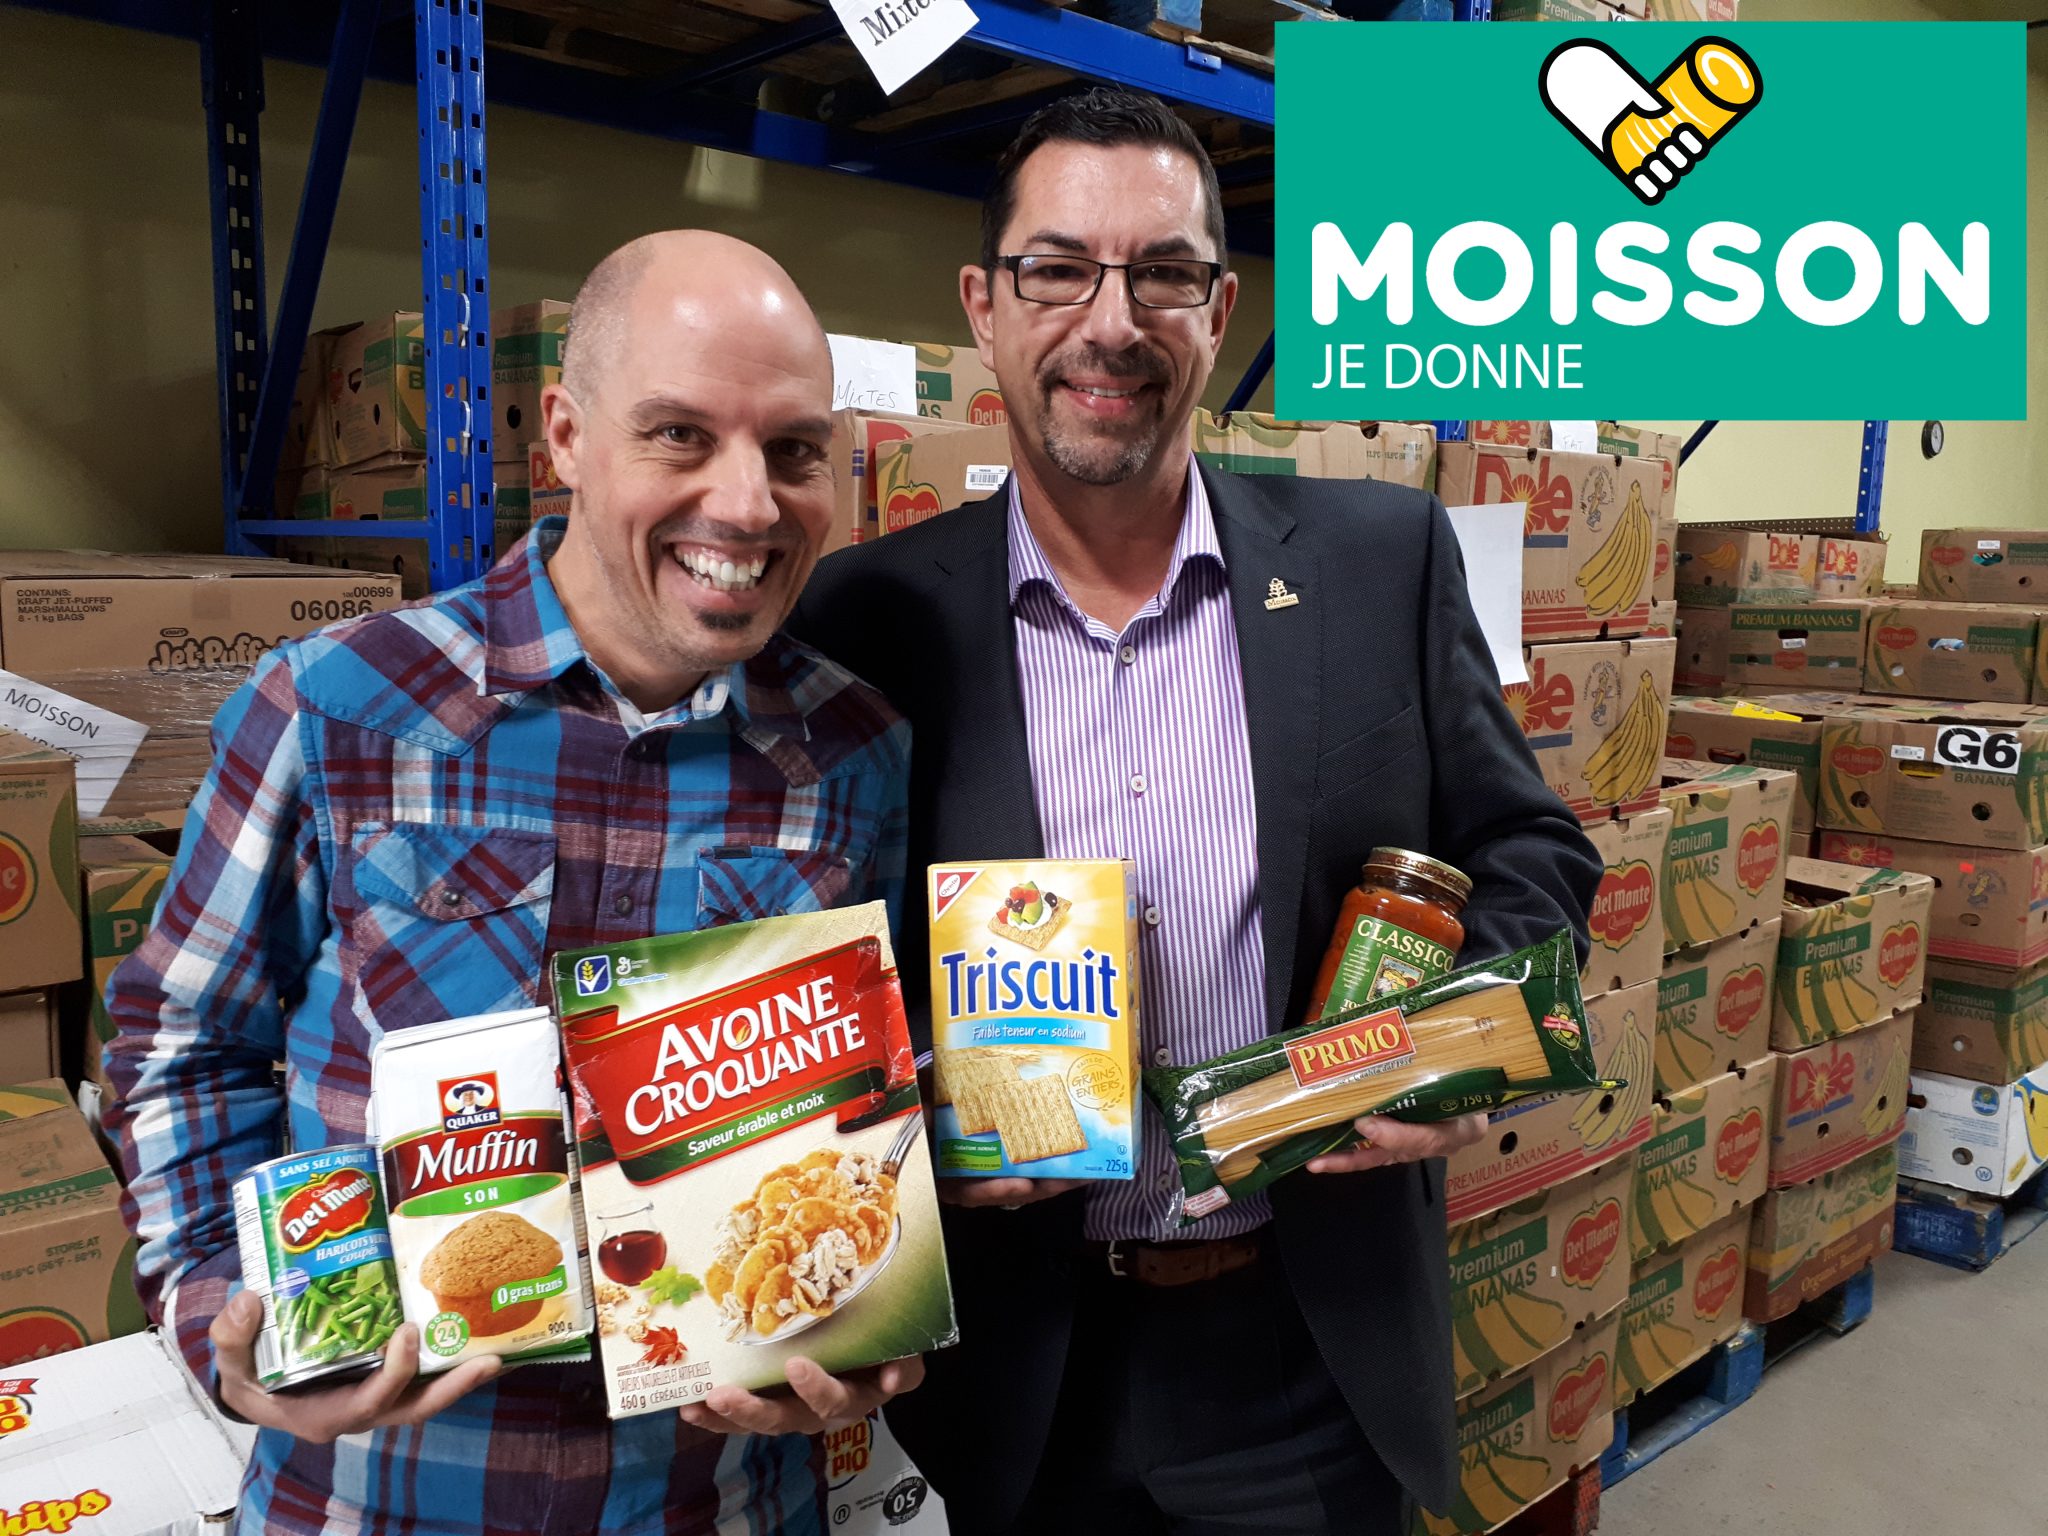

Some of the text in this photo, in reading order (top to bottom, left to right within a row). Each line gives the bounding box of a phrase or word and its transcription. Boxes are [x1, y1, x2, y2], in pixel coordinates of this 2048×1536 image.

[859, 0, 936, 46] Mixte
[974, 407, 994, 426] Del
[1597, 439, 1630, 456] remium
[531, 451, 566, 488] Do
[1474, 452, 1573, 537] Dole
[533, 500, 572, 518] BANANA
[889, 507, 938, 528] Del Monte
[1768, 536, 1801, 564] Dole
[1824, 542, 1858, 575] Dole
[16, 589, 71, 597] CONTAINS:
[17, 596, 113, 605] KRAFT JET-PUFFED
[17, 605, 106, 614] MARSHMALLOWS
[34, 614, 39, 622] 1
[42, 614, 55, 623] kg
[56, 613, 85, 621] BAGS
[291, 599, 373, 621] 06086
[1736, 613, 1854, 626] PREMIUM BANANAS
[148, 632, 292, 672] Jet-Puff
[1501, 657, 1574, 736] ole
[4, 688, 100, 739] MOISSON
[1754, 748, 1805, 764] Premium
[1937, 728, 2017, 769] G6
[1955, 773, 2016, 788] BANANA
[1670, 831, 1713, 856] emium
[1672, 855, 1720, 886] NANAS
[1594, 884, 1650, 916] Del Monte
[1357, 919, 1454, 973] CLASSICO
[1805, 936, 1858, 961] Premium
[1881, 941, 1919, 963] Del Monte
[942, 946, 1121, 1019] Triscuit
[1803, 956, 1863, 988] BNANAS
[1720, 985, 1763, 1013] Del Monte
[1934, 1003, 1995, 1021] BANANA
[650, 975, 839, 1084] AVOINE
[972, 1025, 1087, 1041] Faible teneur en sodium
[1295, 1022, 1402, 1074] PRIMO
[624, 1012, 866, 1137] CROQUANTE
[1071, 1067, 1116, 1089] GRAINS
[1788, 1044, 1857, 1114] Dole
[1076, 1078, 1121, 1100] ENTIERS
[1462, 1094, 1493, 1107] 750 g
[1373, 1093, 1417, 1115] hetti
[445, 1110, 499, 1130] QUAKER
[687, 1091, 825, 1158] Saveur érable et noix
[411, 1129, 538, 1190] Muffin
[1637, 1134, 1689, 1167] remium
[279, 1161, 311, 1178] SANS
[311, 1158, 332, 1171] SEL
[1106, 1158, 1129, 1174] 225g
[1445, 1138, 1560, 1194] PREMIUM BANANAS
[1648, 1155, 1698, 1191] NANAS
[463, 1186, 500, 1206] SON
[284, 1177, 371, 1244] Del Monte
[46, 1236, 100, 1257] STORE AT
[315, 1237, 369, 1262] HARICOTS
[1566, 1219, 1619, 1264] Del Monte
[338, 1246, 379, 1265] coupés
[496, 1276, 564, 1305] 0 gras trans
[1470, 1260, 1537, 1310] NANAS
[1623, 1278, 1668, 1311] emium
[428, 1313, 466, 1331] DONNE
[548, 1322, 566, 1336] 900
[1628, 1298, 1675, 1337] NANAS
[429, 1336, 469, 1356] MUFFINS
[437, 1325, 457, 1342] 24
[620, 1394, 638, 1410] 460
[639, 1395, 646, 1409] g
[649, 1384, 688, 1405] CÉRÉALES
[1553, 1396, 1573, 1421] Del
[1457, 1402, 1513, 1443] emium
[825, 1421, 867, 1452] Dut
[1460, 1422, 1524, 1472] NANAS
[832, 1446, 868, 1477] Old
[0, 1488, 111, 1536] hips
[893, 1487, 918, 1513] 50
